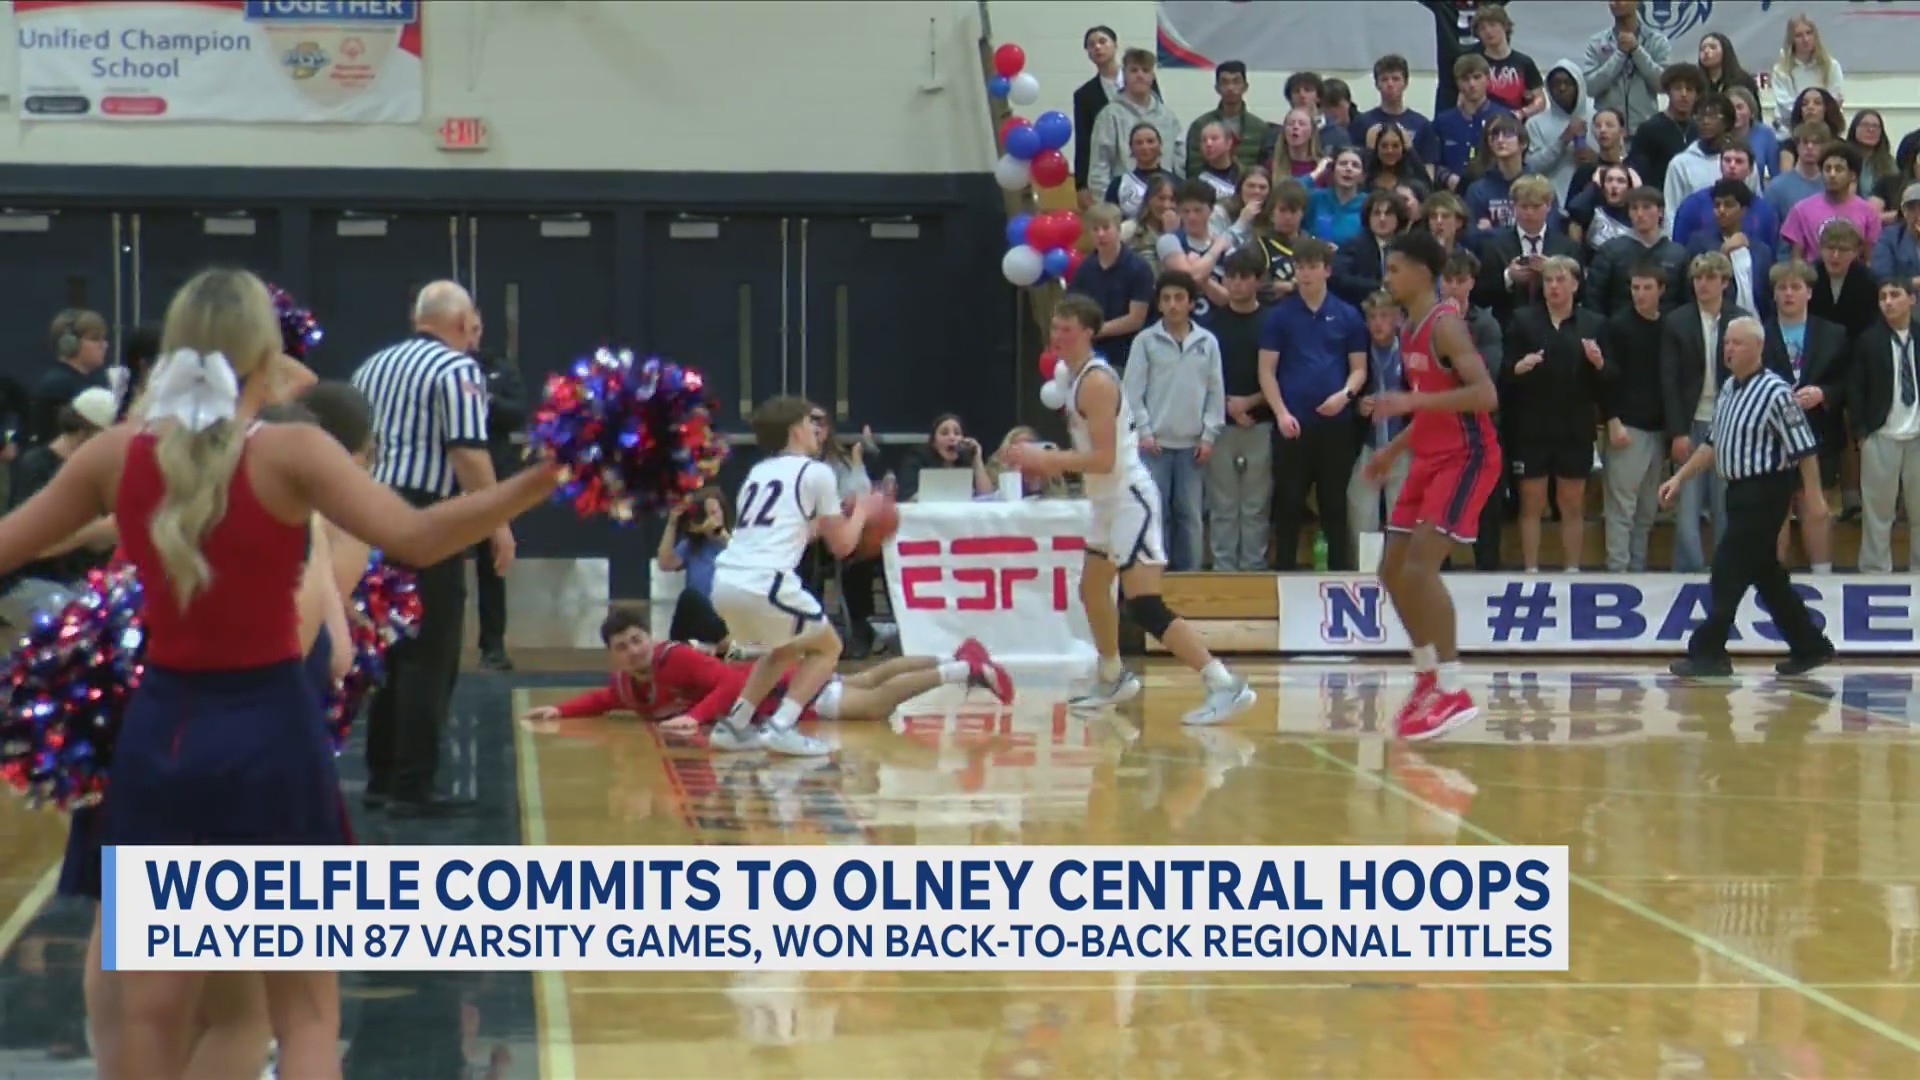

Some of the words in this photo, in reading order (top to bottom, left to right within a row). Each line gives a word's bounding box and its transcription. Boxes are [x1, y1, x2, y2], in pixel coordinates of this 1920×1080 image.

[261, 1, 404, 14] TOGETHER
[18, 29, 110, 50] Unified
[121, 29, 250, 56] Champion
[91, 57, 179, 78] School
[737, 479, 784, 528] 22
[1322, 583, 1384, 641] N
